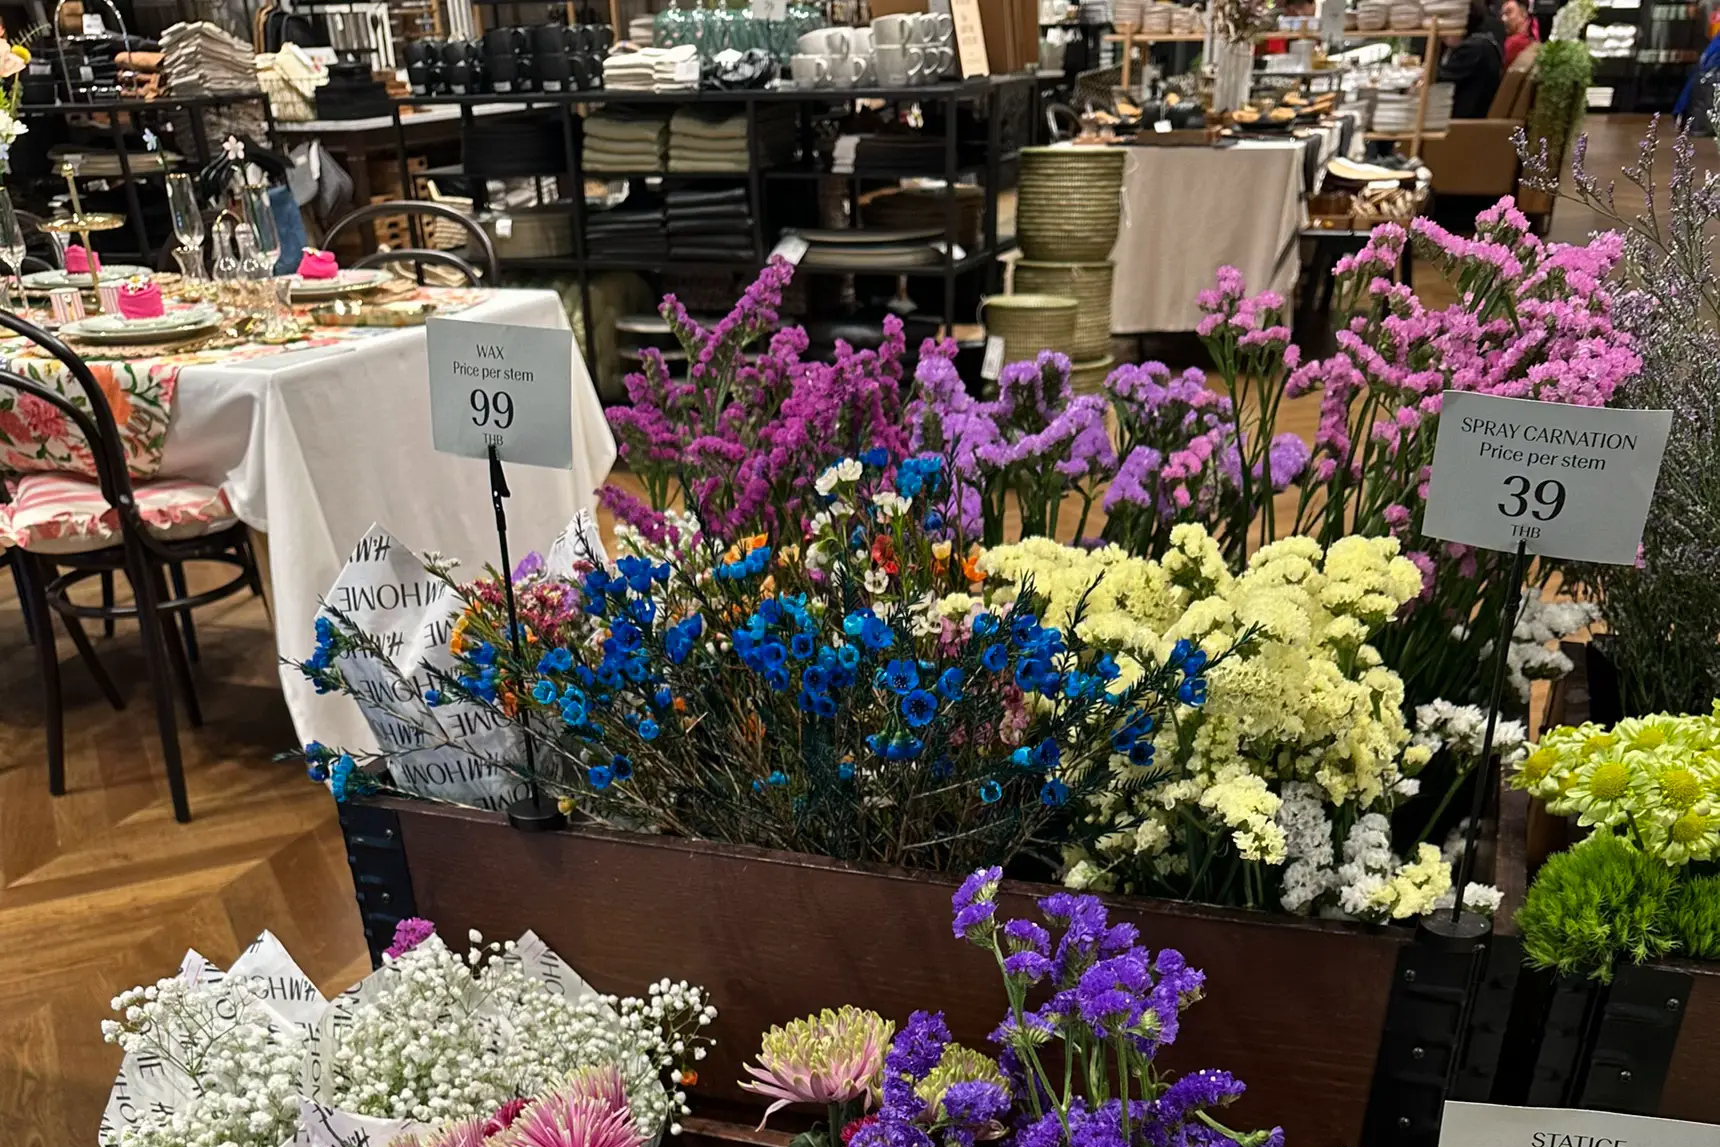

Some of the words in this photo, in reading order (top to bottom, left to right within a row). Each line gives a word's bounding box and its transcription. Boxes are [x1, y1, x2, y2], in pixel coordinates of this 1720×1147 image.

[476, 344, 505, 360] WAX
[453, 360, 480, 377] Price
[482, 366, 501, 381] per
[503, 368, 534, 382] stem
[470, 388, 514, 429] 99
[482, 432, 504, 447] THB
[1460, 416, 1521, 440] SPRAY
[1523, 425, 1638, 451] CARNATION
[1479, 442, 1524, 462] Price
[1527, 452, 1559, 467] per
[1560, 455, 1606, 471] stem
[1497, 475, 1567, 521] 39
[1510, 523, 1541, 539] THB
[337, 582, 422, 612] HOME
